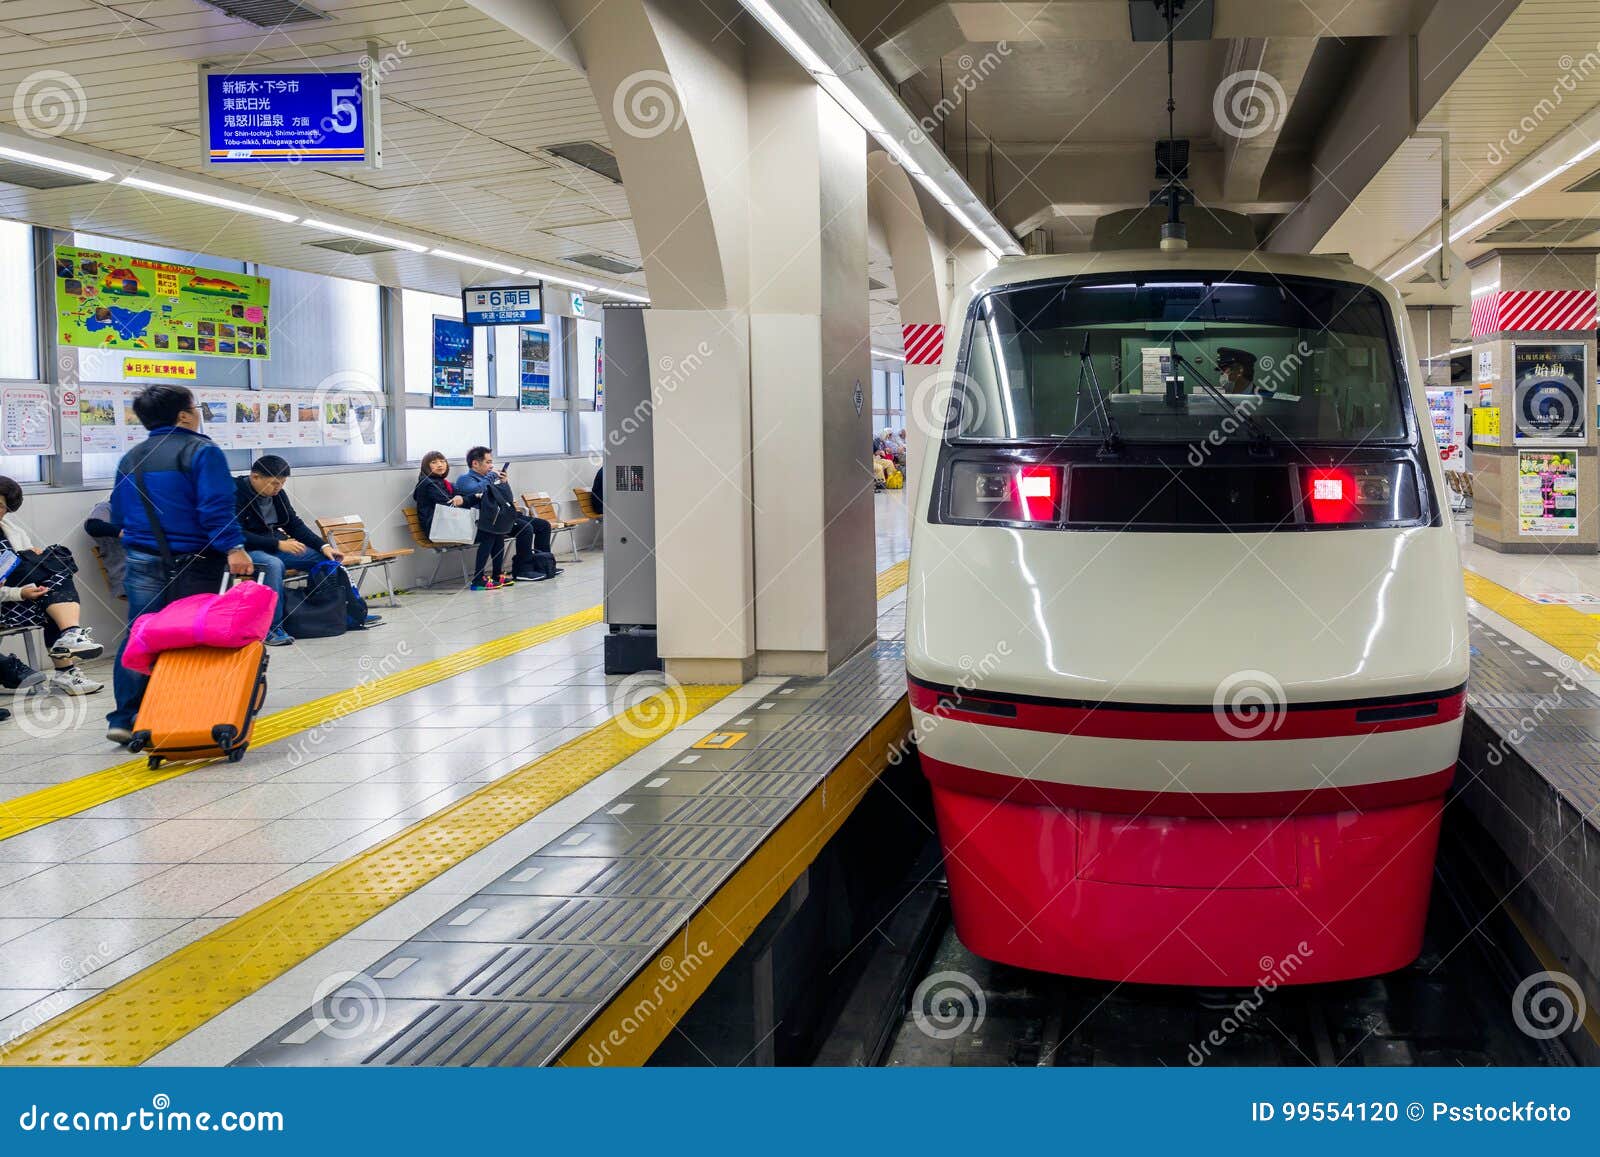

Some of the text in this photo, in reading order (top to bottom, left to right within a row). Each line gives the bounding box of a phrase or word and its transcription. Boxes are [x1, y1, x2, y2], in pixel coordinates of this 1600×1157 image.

[223, 98, 271, 111] 東武日光
[331, 88, 357, 134] 5
[223, 114, 310, 128] 鬼怒川温泉 方面
[490, 290, 530, 306] 6両目
